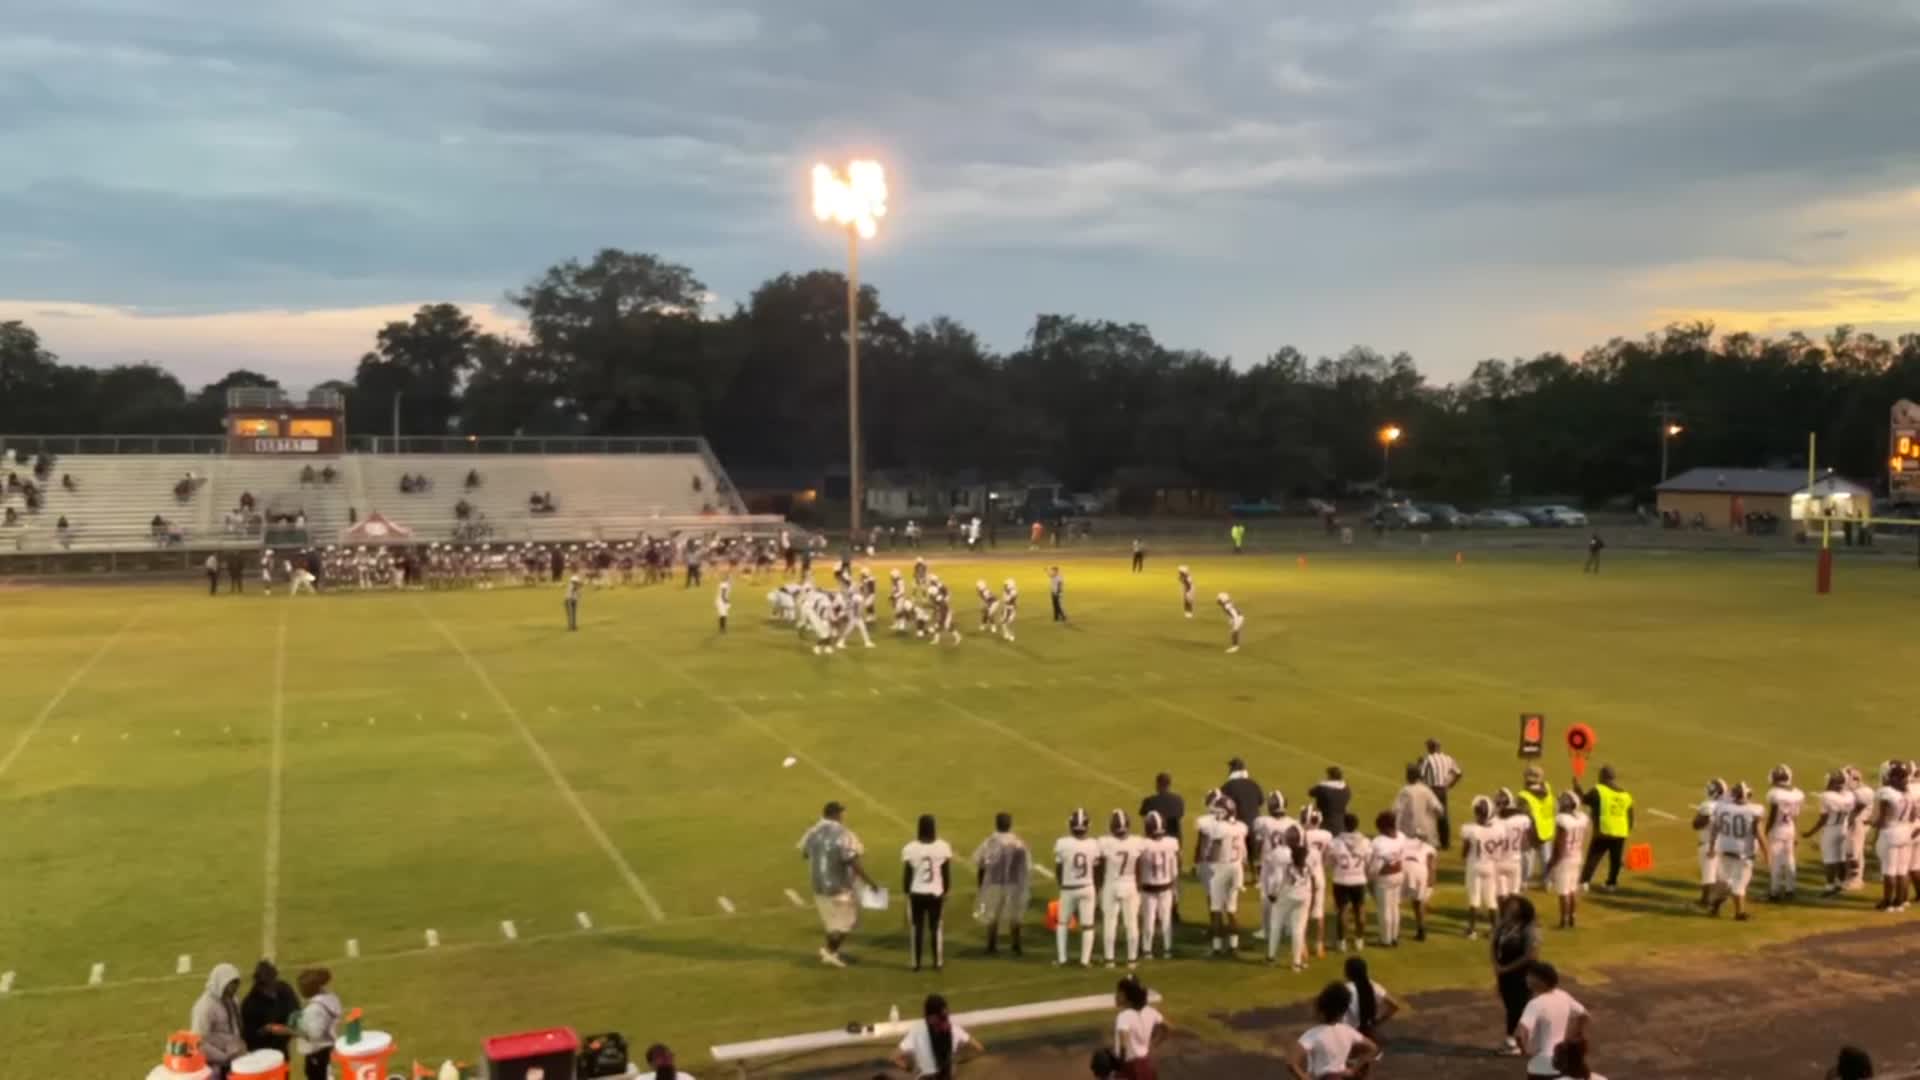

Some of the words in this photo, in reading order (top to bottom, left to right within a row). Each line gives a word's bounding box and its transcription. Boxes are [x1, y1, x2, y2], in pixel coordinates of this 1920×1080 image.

[921, 856, 935, 884] 3
[1073, 851, 1088, 879] 9
[1115, 850, 1129, 876] 7
